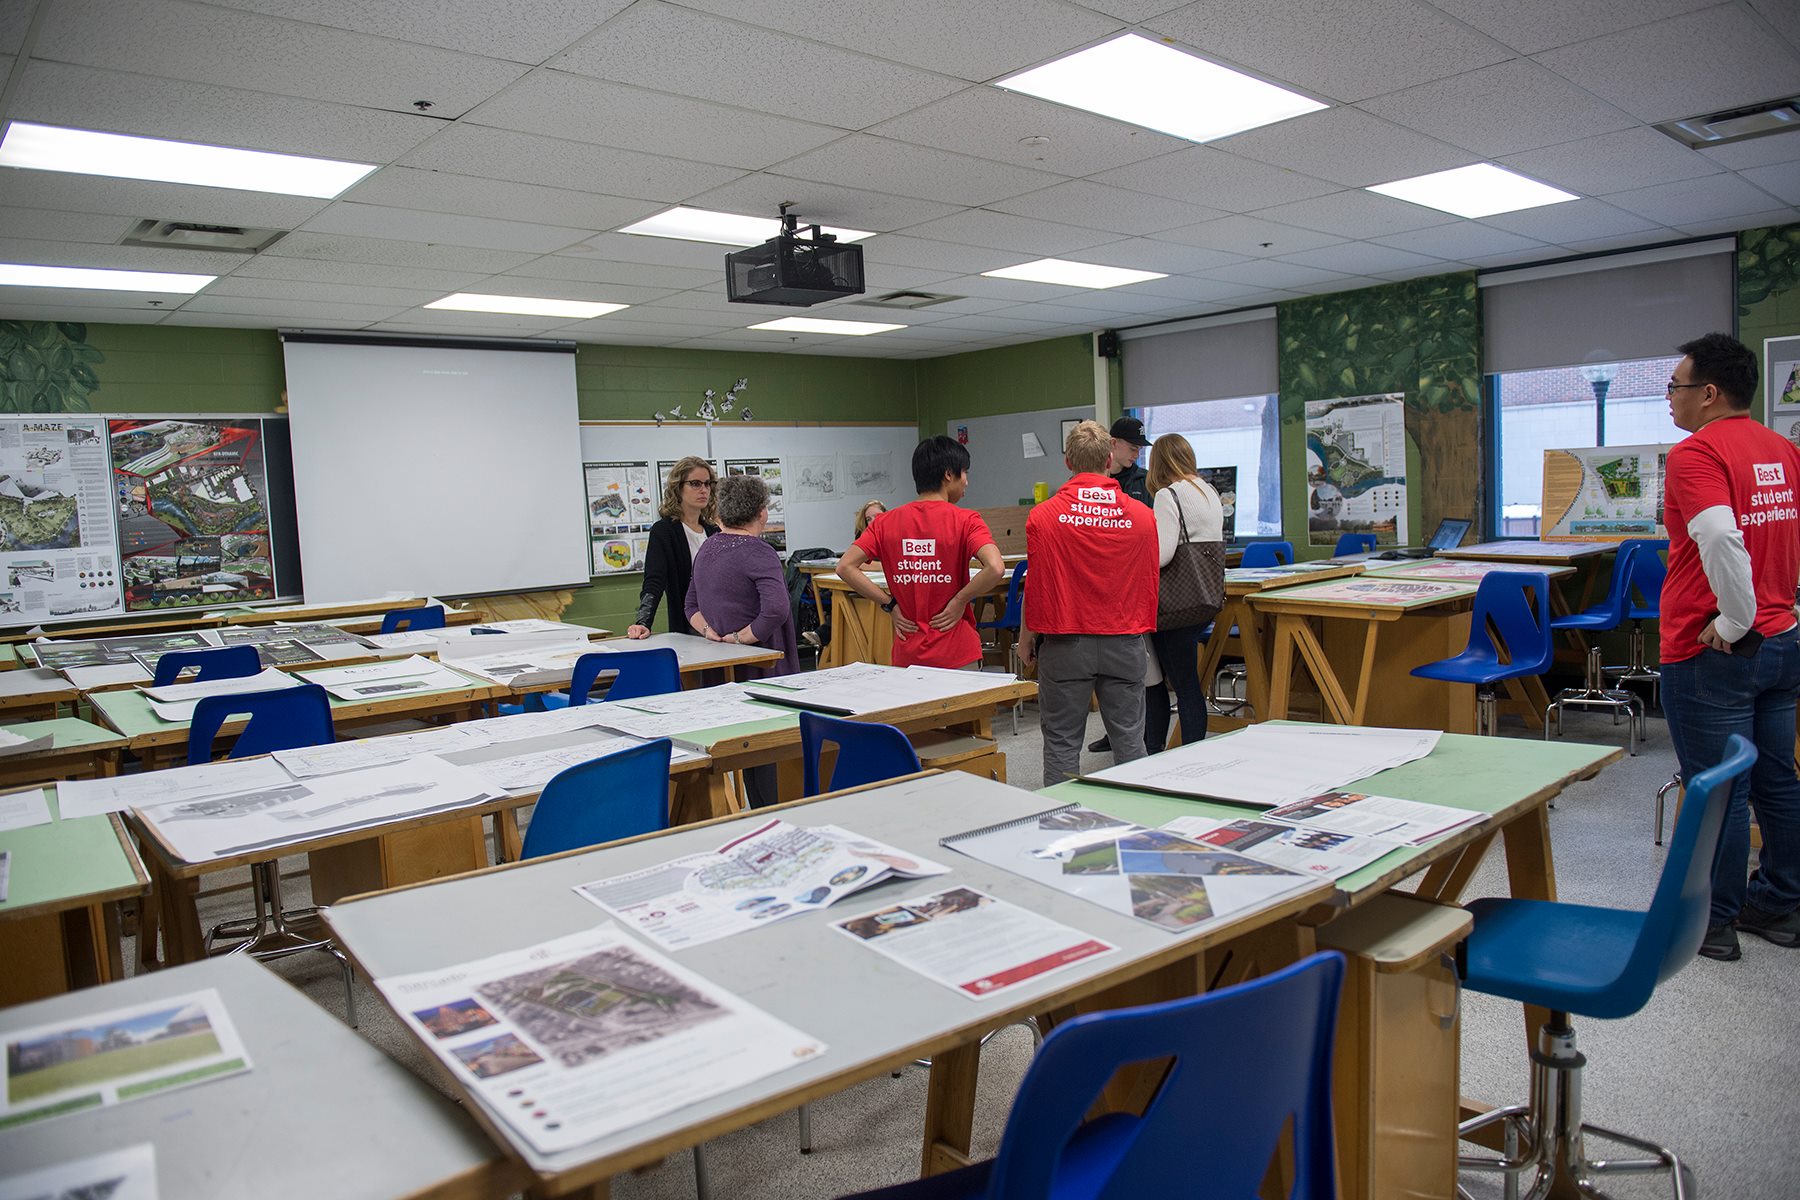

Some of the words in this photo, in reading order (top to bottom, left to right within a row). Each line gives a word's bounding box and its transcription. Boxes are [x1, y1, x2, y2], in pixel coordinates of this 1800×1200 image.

[22, 423, 64, 432] A-MAZE
[1757, 467, 1782, 481] Best
[1081, 489, 1113, 501] Best
[1751, 488, 1794, 507] student
[1070, 502, 1124, 517] student
[1058, 513, 1133, 529] experience
[905, 541, 932, 553] Best
[897, 558, 942, 571] student
